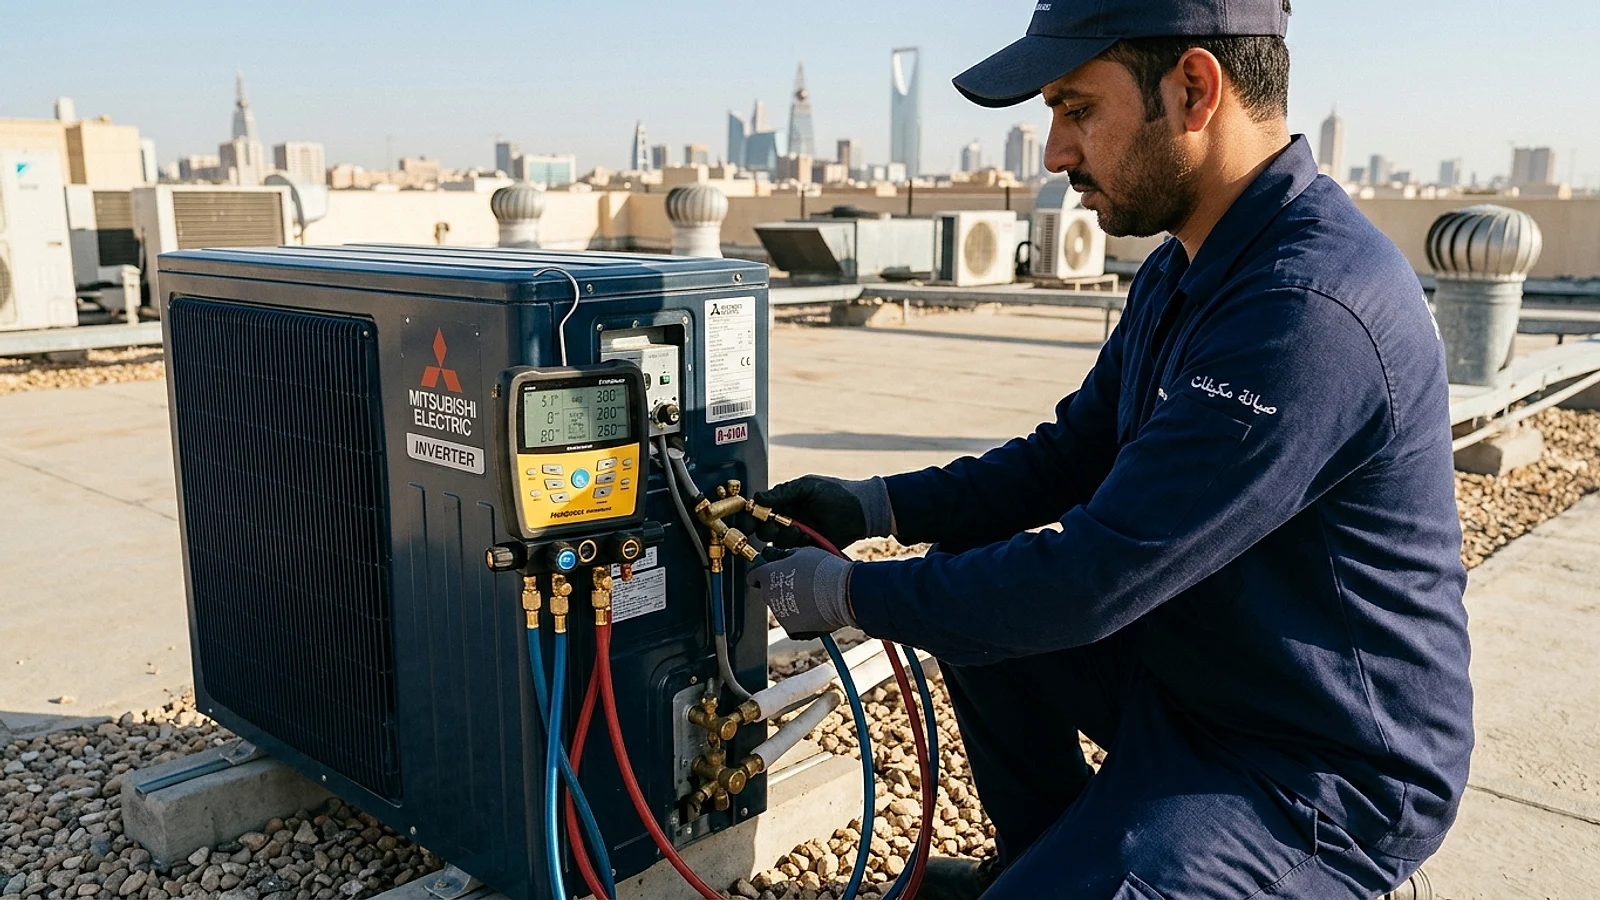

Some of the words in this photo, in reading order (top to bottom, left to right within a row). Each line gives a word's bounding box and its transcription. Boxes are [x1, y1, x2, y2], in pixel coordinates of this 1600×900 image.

[408, 388, 477, 419] MITSUBISHI
[414, 409, 472, 437] ELECTRIC
[414, 440, 475, 468] INVERTER
